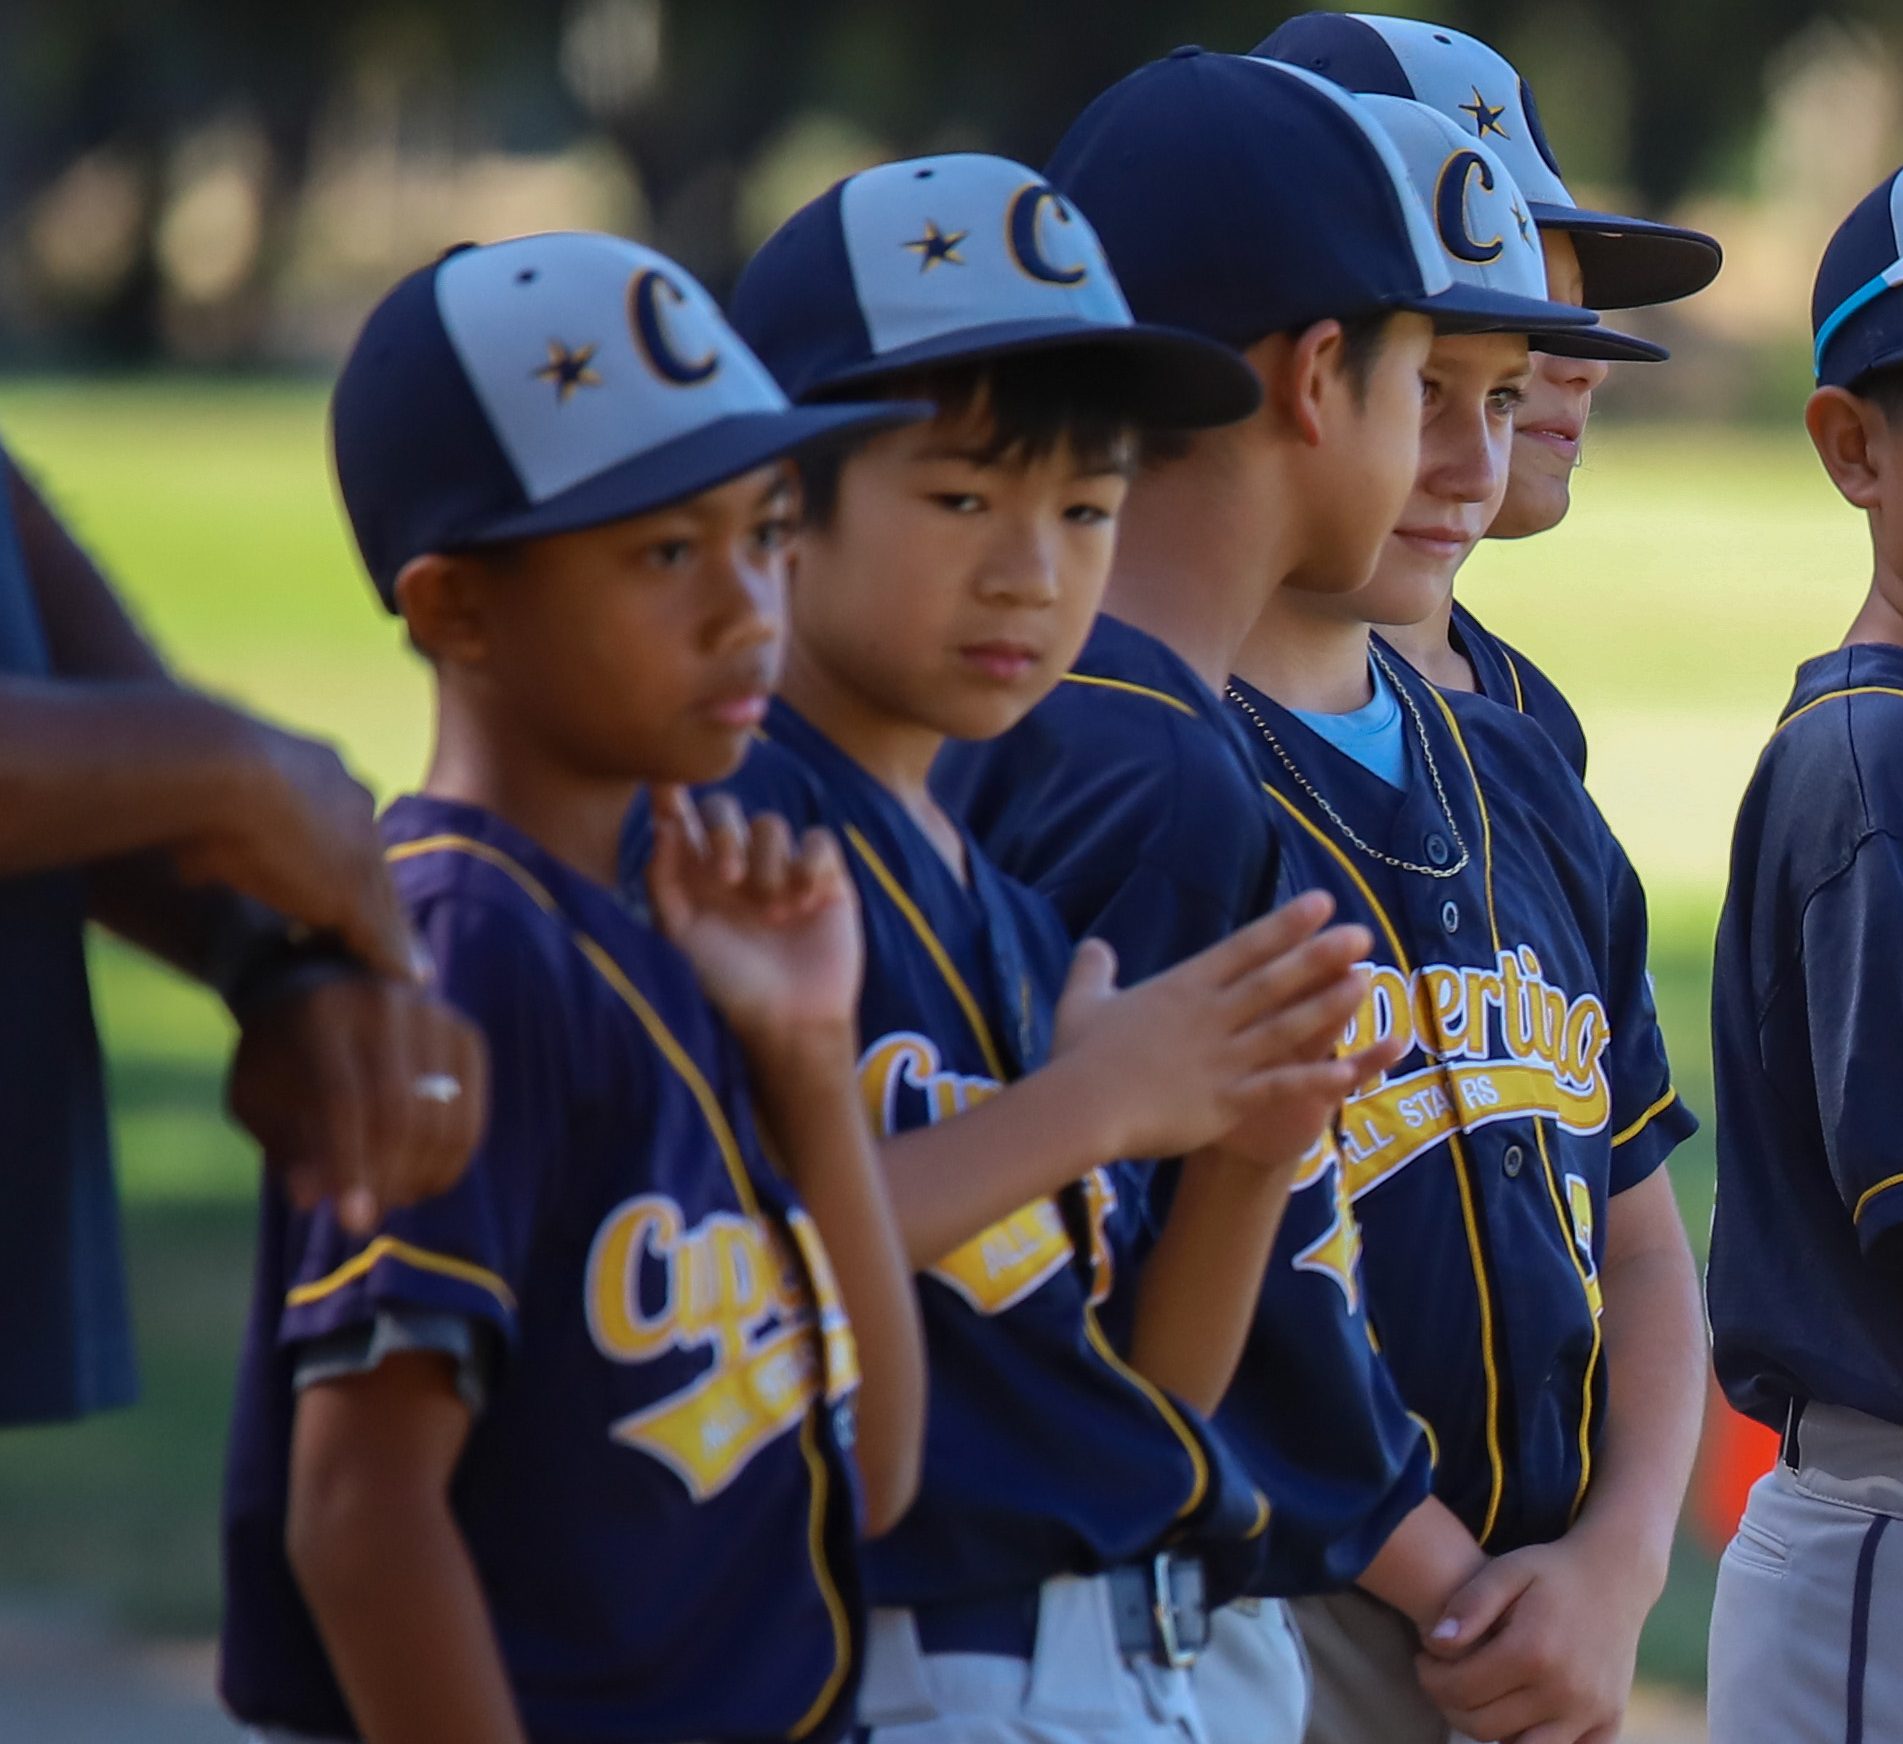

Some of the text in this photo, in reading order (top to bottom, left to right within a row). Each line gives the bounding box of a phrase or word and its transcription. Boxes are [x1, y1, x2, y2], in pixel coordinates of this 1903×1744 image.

[1004, 181, 1087, 288] C
[1434, 148, 1504, 266] C
[625, 267, 722, 387] C
[1335, 944, 1612, 1098] pertino
